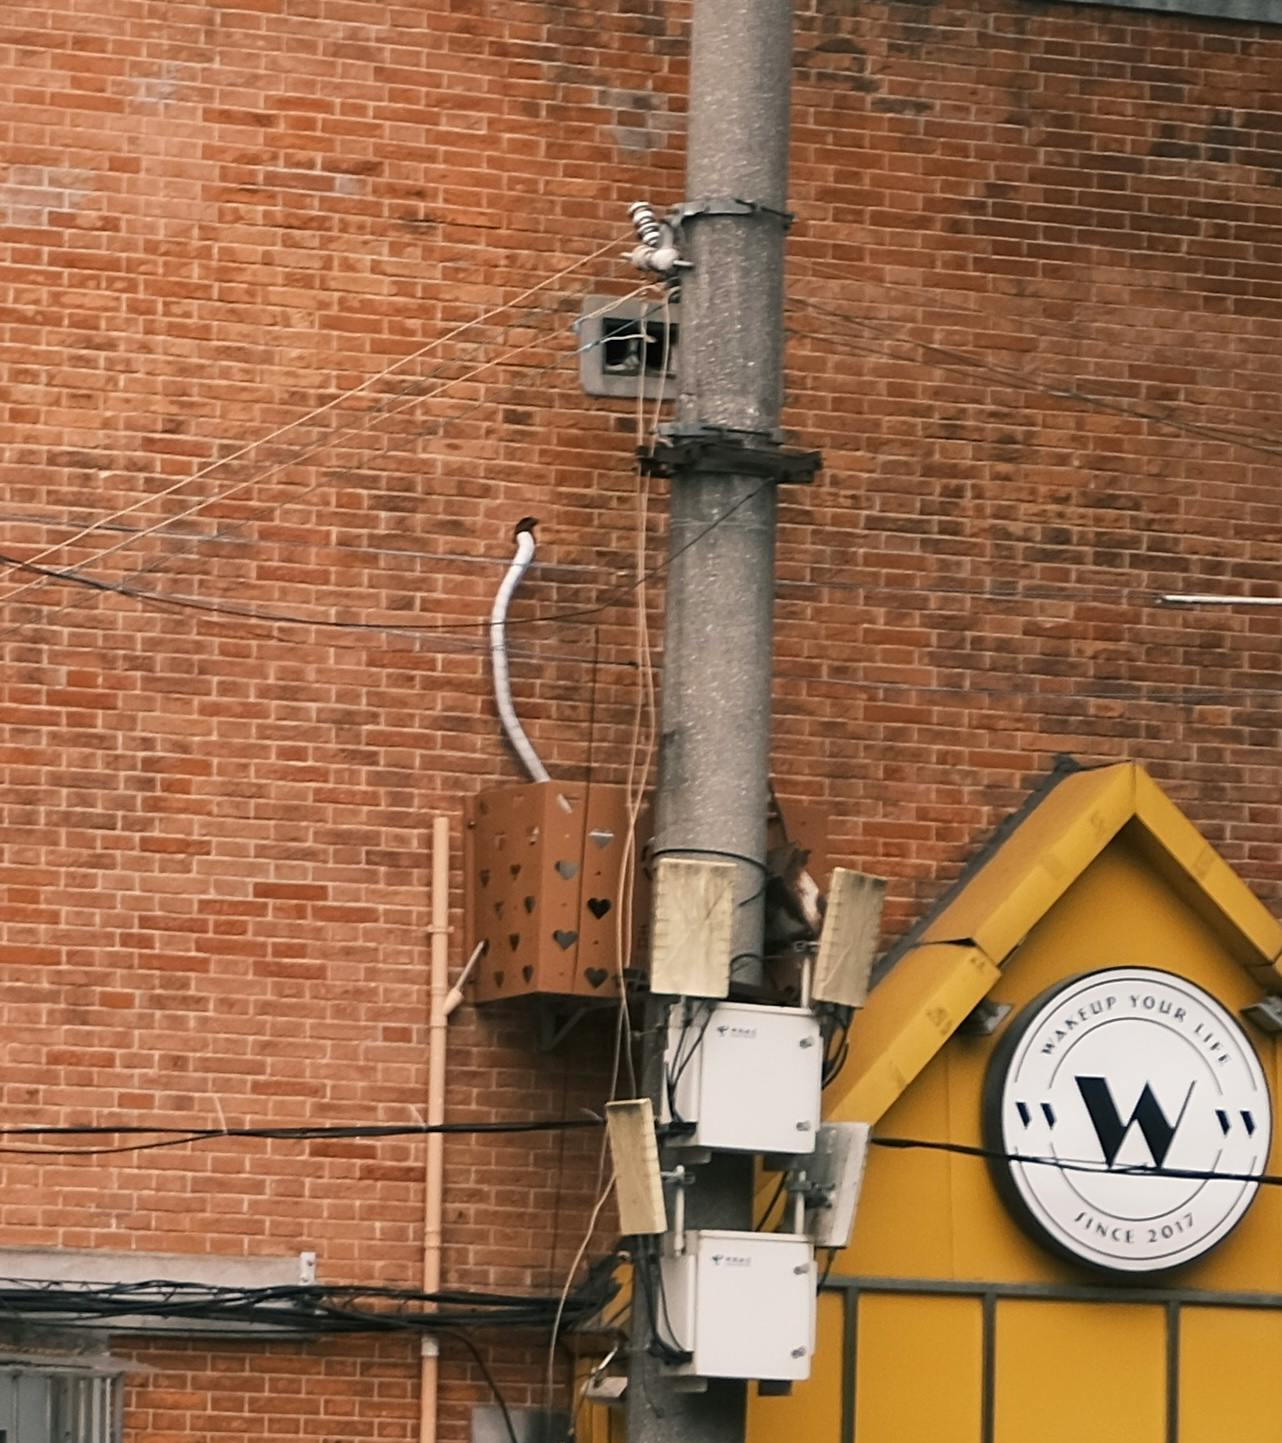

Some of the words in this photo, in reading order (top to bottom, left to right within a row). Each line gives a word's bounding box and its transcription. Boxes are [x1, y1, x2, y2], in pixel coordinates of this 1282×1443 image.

[1042, 995, 1117, 1056] WAKEUP
[1129, 994, 1188, 1023] YOUR
[1194, 1022, 1232, 1065] LIFE
[1074, 1211, 1135, 1243] SINCE
[1148, 1213, 1195, 1243] 2017
